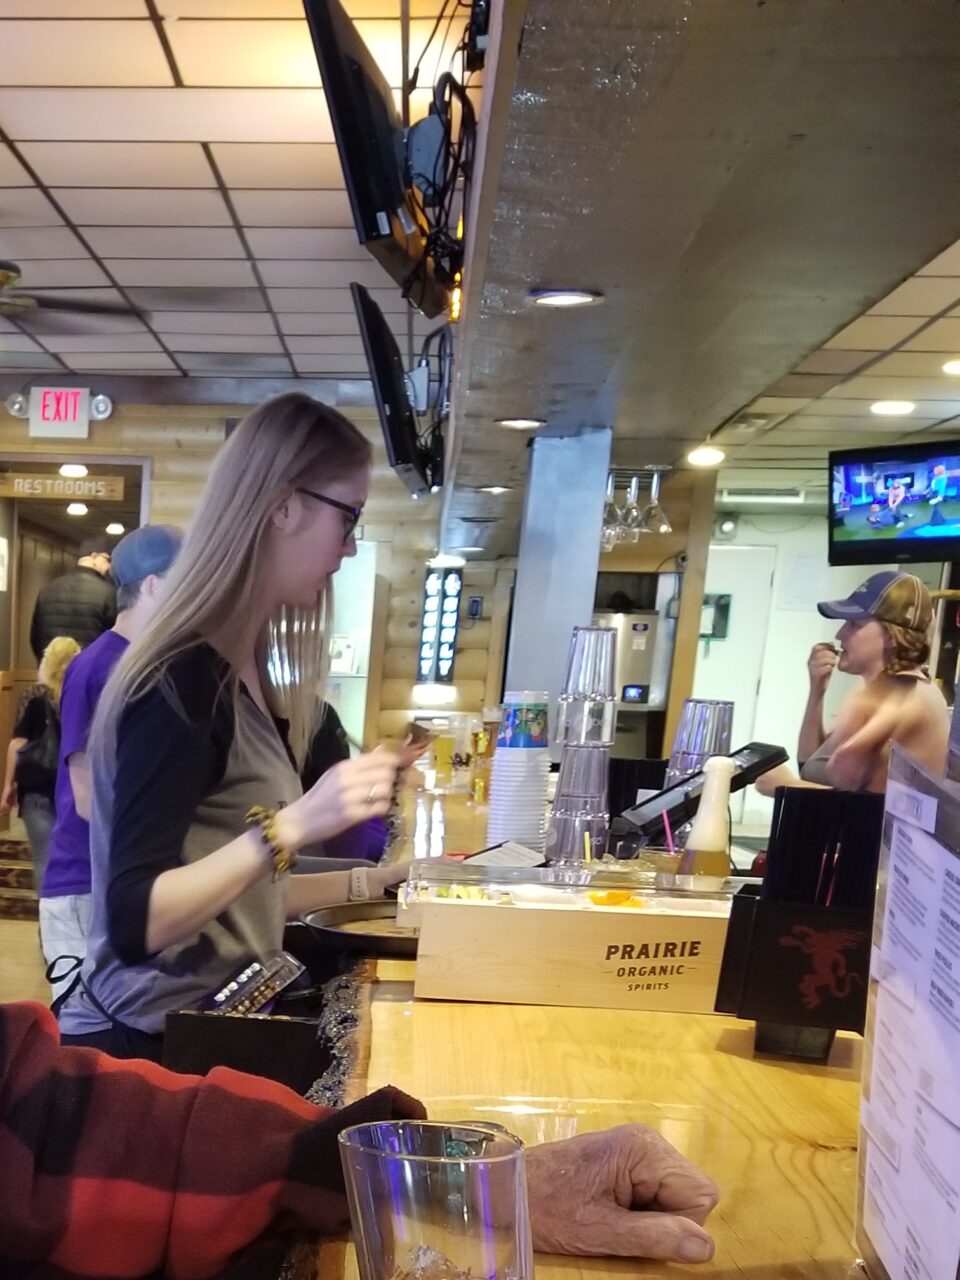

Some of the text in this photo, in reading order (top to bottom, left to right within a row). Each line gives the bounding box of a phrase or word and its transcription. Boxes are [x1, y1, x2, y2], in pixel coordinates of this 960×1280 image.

[41, 391, 82, 421] EXIT
[14, 478, 106, 496] RESTROOMS
[605, 940, 702, 961] PRAIRIE
[617, 964, 685, 978] ORGANIC
[628, 982, 670, 992] SPIRITS
